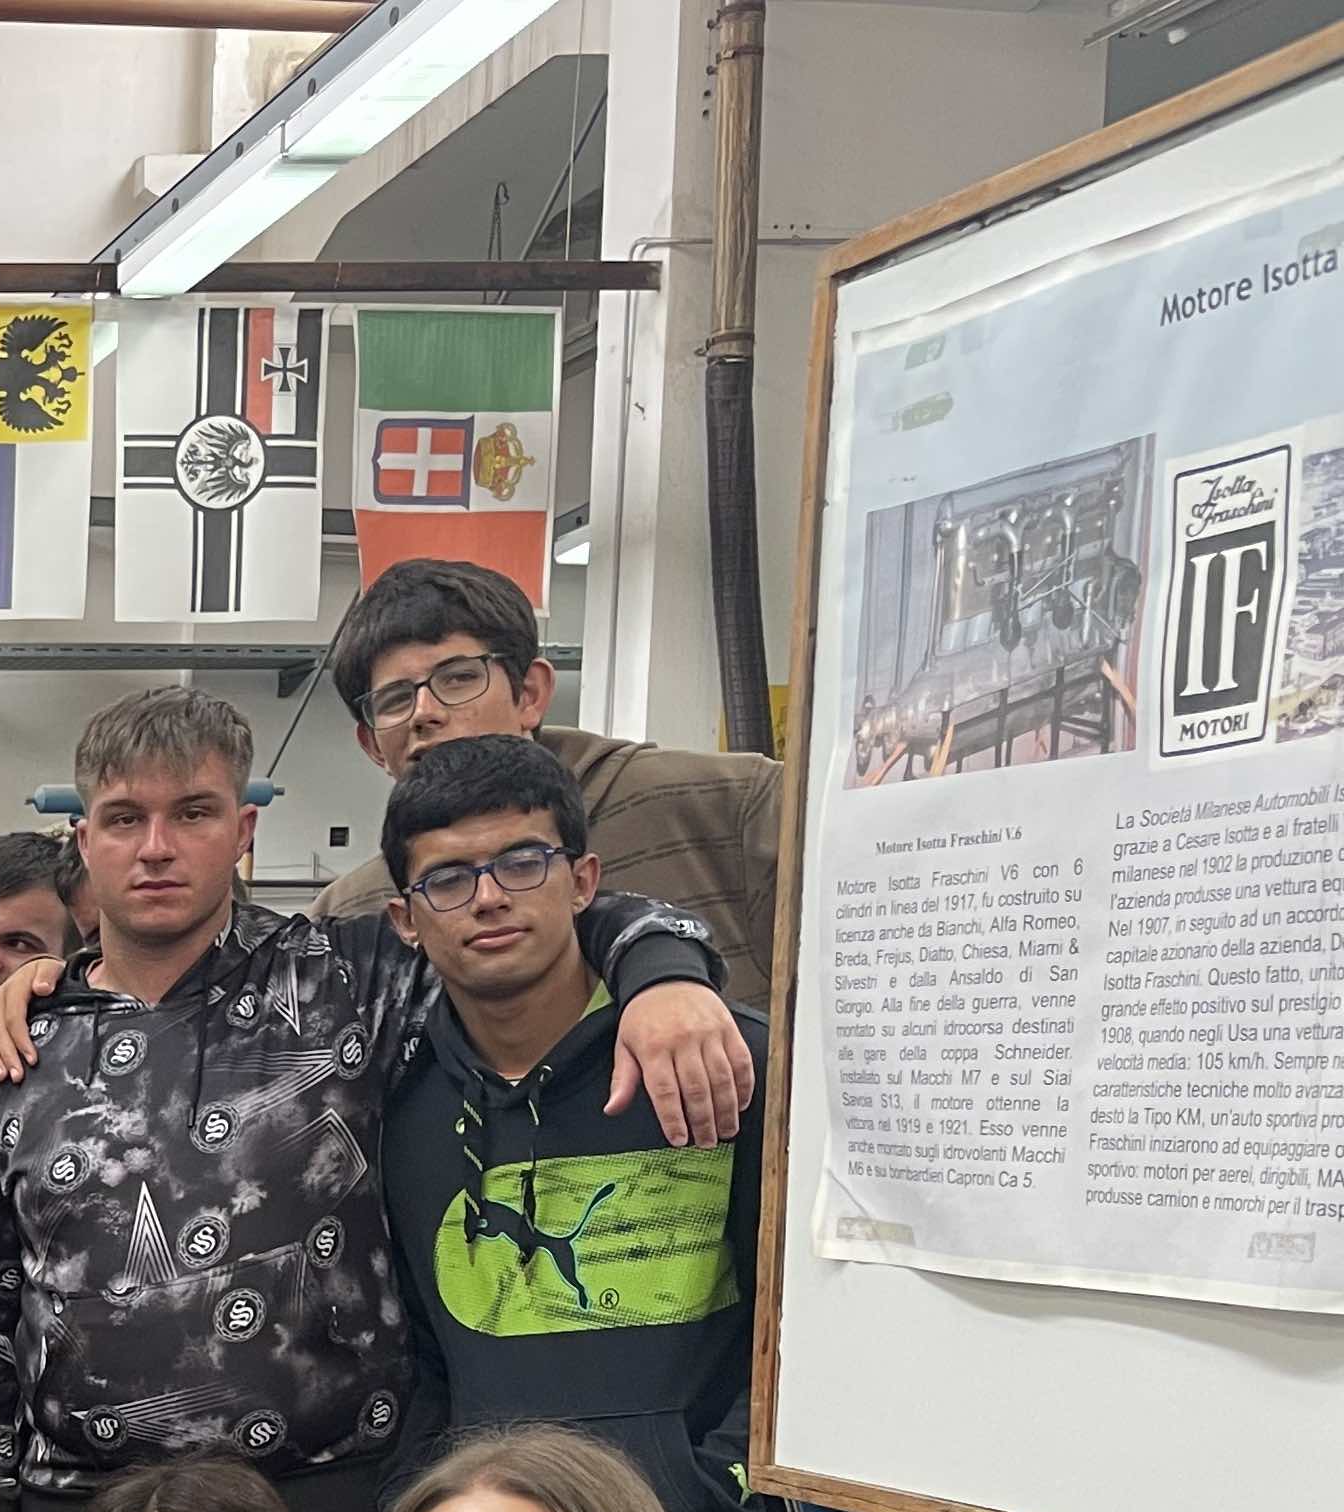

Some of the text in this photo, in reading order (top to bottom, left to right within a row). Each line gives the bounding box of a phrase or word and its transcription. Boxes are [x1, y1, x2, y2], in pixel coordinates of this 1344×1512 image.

[1160, 249, 1338, 326] Motore Isotta
[1201, 474, 1257, 502] Isotta
[1185, 488, 1278, 537] Fraschini
[1179, 541, 1268, 697] IF
[1180, 712, 1250, 742] MOTORI
[1115, 812, 1135, 830] La
[1253, 786, 1331, 812] Automobili
[875, 828, 1002, 855] Motore Isotta Fraschini
[1113, 813, 1339, 860] grazie a Cesare Isotta e fratelli
[837, 858, 1083, 896] Motore Isotta Fraschini V6 con 6
[1112, 863, 1176, 883] milanese
[1179, 858, 1197, 878] nel
[1203, 854, 1233, 874] 1902
[1235, 853, 1247, 872] la
[1252, 847, 1332, 874] produzione
[921, 896, 940, 914] del
[998, 889, 1060, 907] costruito
[1064, 888, 1082, 903] su
[1174, 879, 1317, 908] produsse una vettura
[917, 923, 933, 938] da
[936, 919, 985, 936] Bianchi,
[991, 916, 1017, 932] Alfa
[1108, 919, 1132, 937] Nel
[1189, 913, 1236, 935] seguito
[1239, 909, 1259, 928] ad
[1263, 911, 1281, 926] un
[962, 944, 1012, 960] Chiesa,
[1068, 938, 1080, 955] &
[1106, 946, 1157, 966] capitale
[1160, 942, 1218, 961] azionario
[1221, 938, 1255, 958] della
[950, 968, 1003, 985] Ansaldo
[1019, 966, 1032, 983] di
[1049, 965, 1079, 981] San
[1104, 973, 1141, 991] Isotta
[1208, 967, 1261, 986] Questo
[1032, 993, 1076, 1008] venne
[1101, 1001, 1147, 1022] grande
[1191, 995, 1246, 1019] positivo
[1252, 994, 1274, 1012] sul
[1278, 992, 1341, 1015] prestigio
[943, 1020, 1003, 1035] idrocorsa
[1012, 1017, 1074, 1034] destinati
[1138, 1025, 1185, 1046] quando
[1189, 1023, 1223, 1046] negli
[1228, 1023, 1258, 1041] Usa
[1263, 1026, 1291, 1041] una
[1295, 1022, 1344, 1041] vettura
[1198, 1052, 1224, 1070] 105
[1273, 1051, 1329, 1073] Sempre
[961, 1069, 982, 1085] M7
[991, 1073, 1000, 1085] e
[1009, 1070, 1031, 1085] sul
[1042, 1069, 1072, 1086] Siai
[1093, 1080, 1292, 1098] caratteristiche tecniche molto
[931, 1095, 1069, 1112] motore ottenne la
[980, 1119, 1014, 1136] Esso
[1022, 1122, 1068, 1137] venne
[1127, 1107, 1318, 1132] la Tipo KM, un'auto sportiva
[1011, 1146, 1065, 1163] Macchi
[1089, 1133, 1146, 1151] Fraschini
[1149, 1135, 1218, 1154] iniziarono
[1222, 1137, 1240, 1154] ad
[1243, 1139, 1330, 1161] equipaggiare
[947, 1168, 1018, 1187] Caproni Ca
[1143, 1162, 1187, 1180] motori
[1192, 1167, 1215, 1183] per
[1085, 1187, 1301, 1218] produsse camion e rimorchi per il
